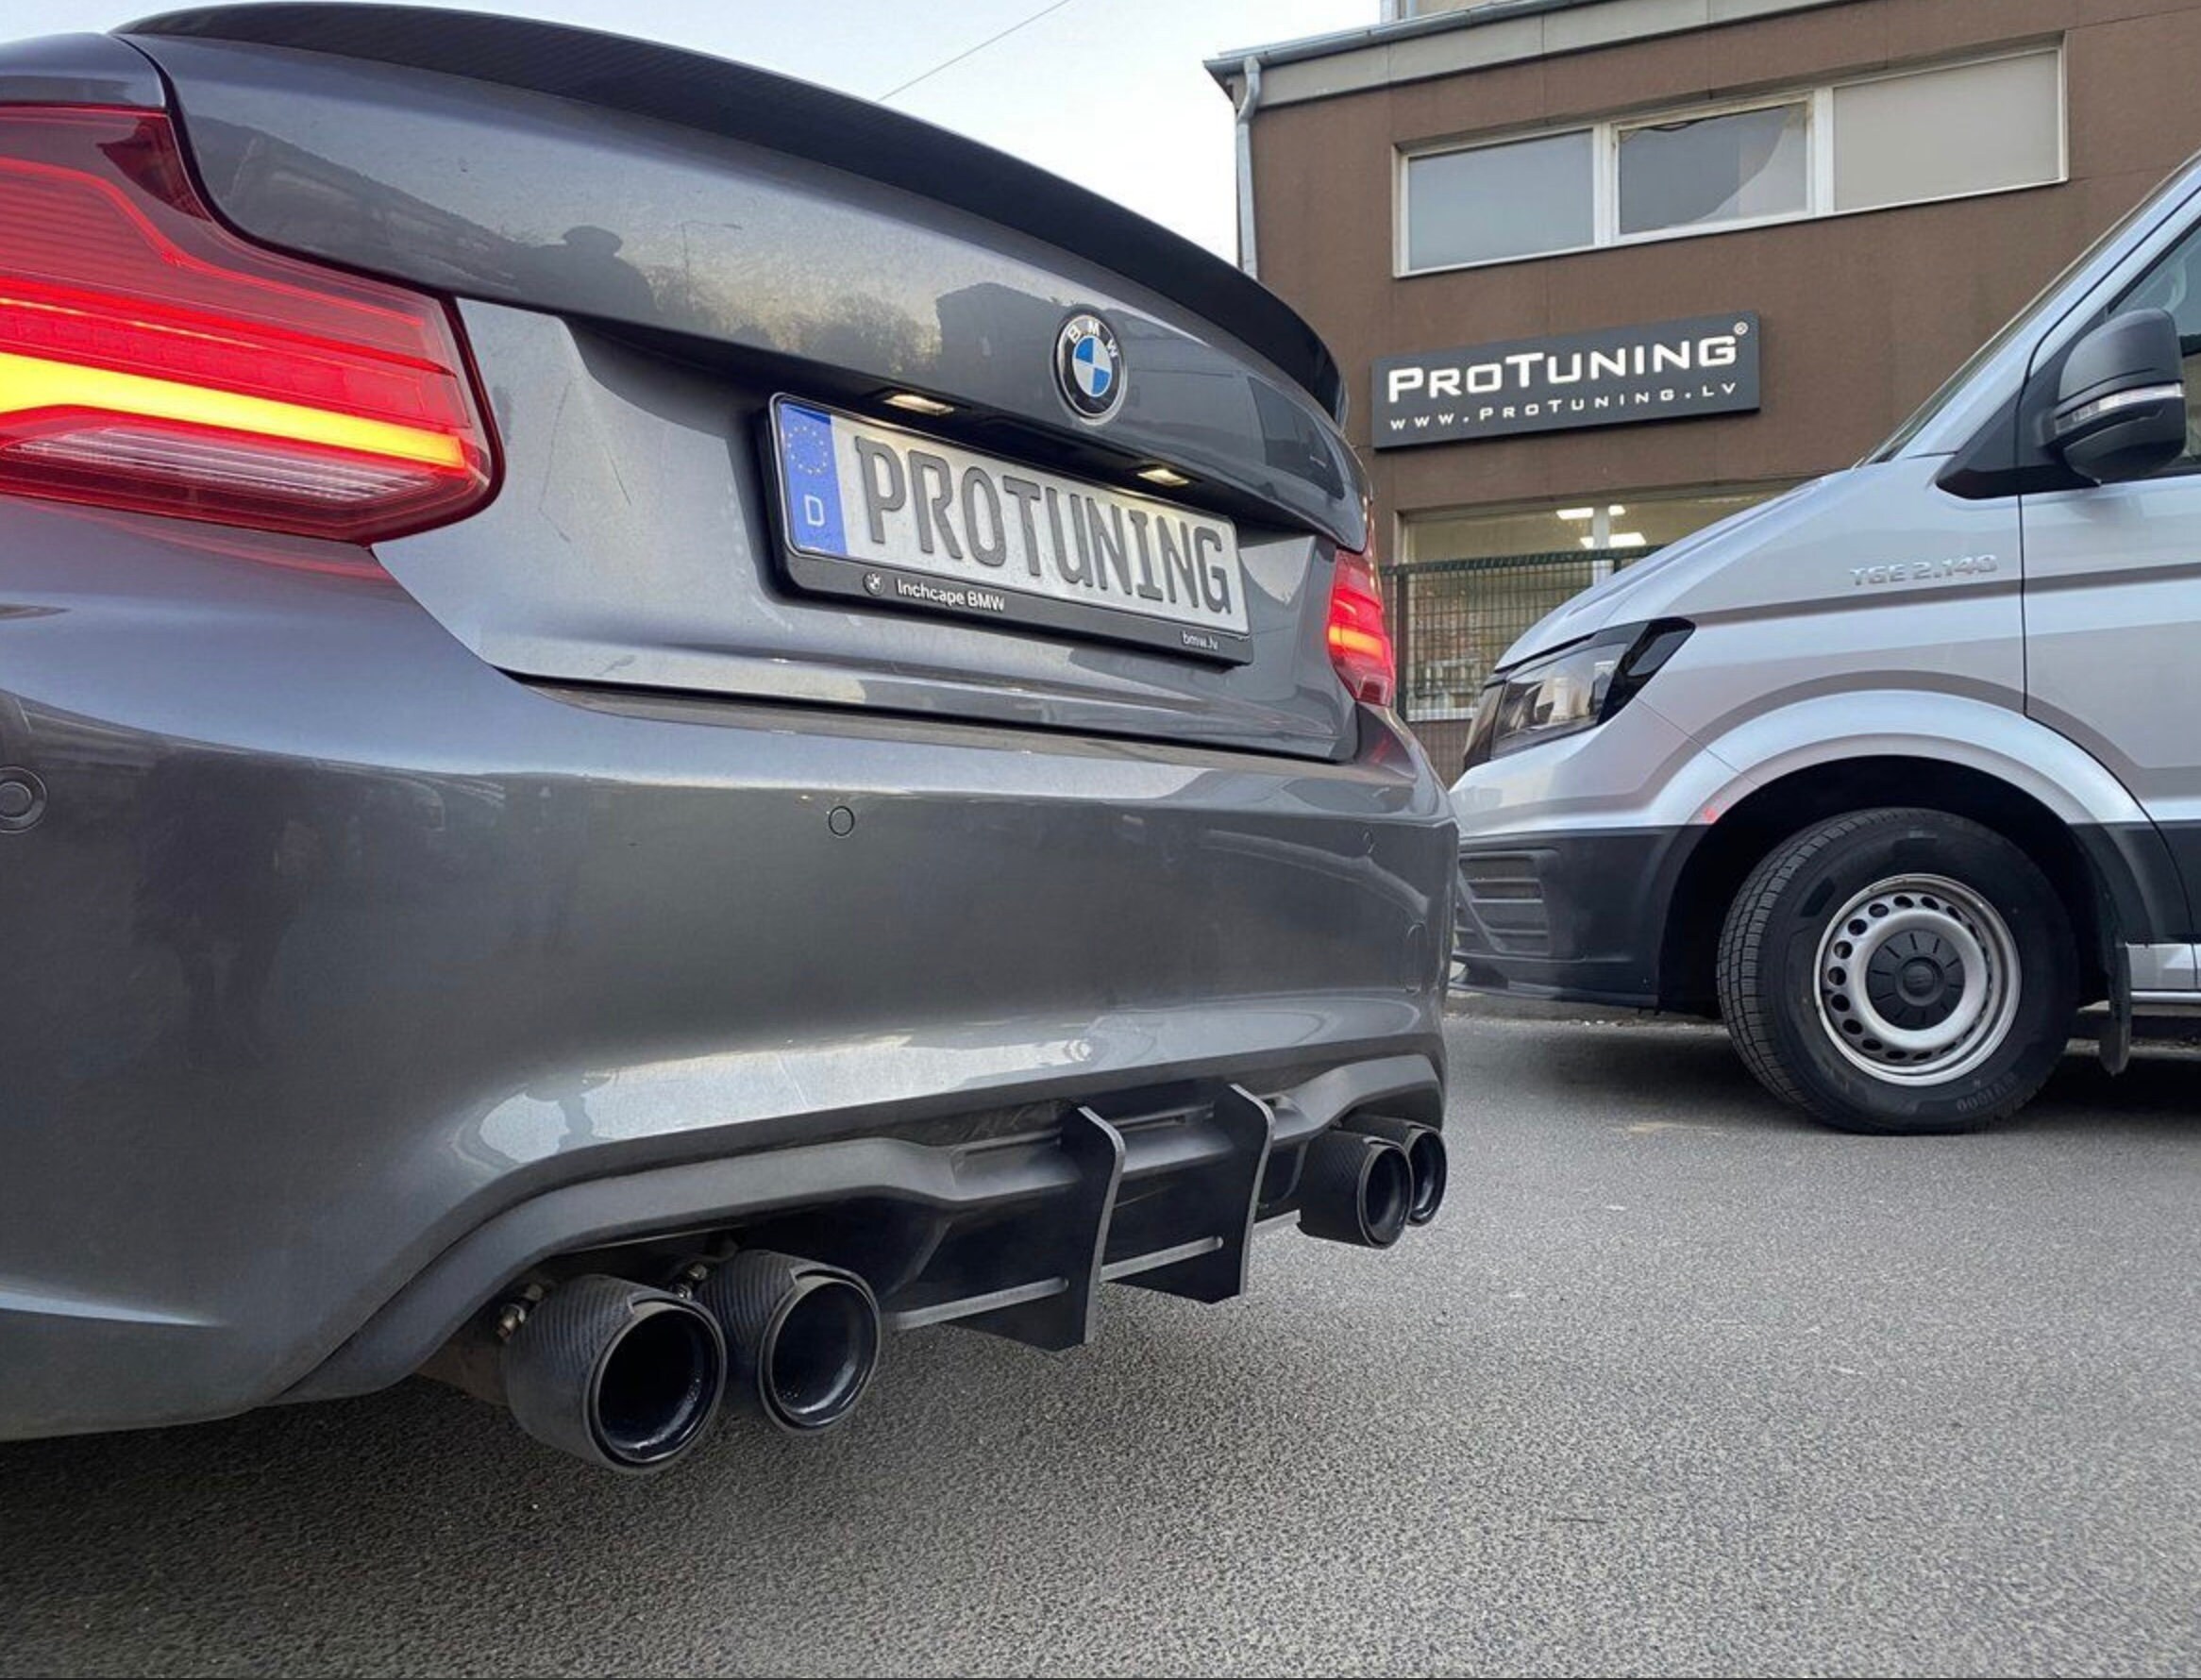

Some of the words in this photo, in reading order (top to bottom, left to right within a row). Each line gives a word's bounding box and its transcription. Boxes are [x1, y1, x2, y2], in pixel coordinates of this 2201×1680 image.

[1065, 319, 1118, 358] BMW
[802, 493, 827, 527] D
[854, 435, 1232, 614] PROTUNING
[1849, 563, 1907, 586] TGE
[1912, 553, 1999, 580] 2.140
[897, 578, 966, 607] Inchcape
[966, 590, 1006, 612] BMW
[1182, 630, 1219, 650] bmw.lv
